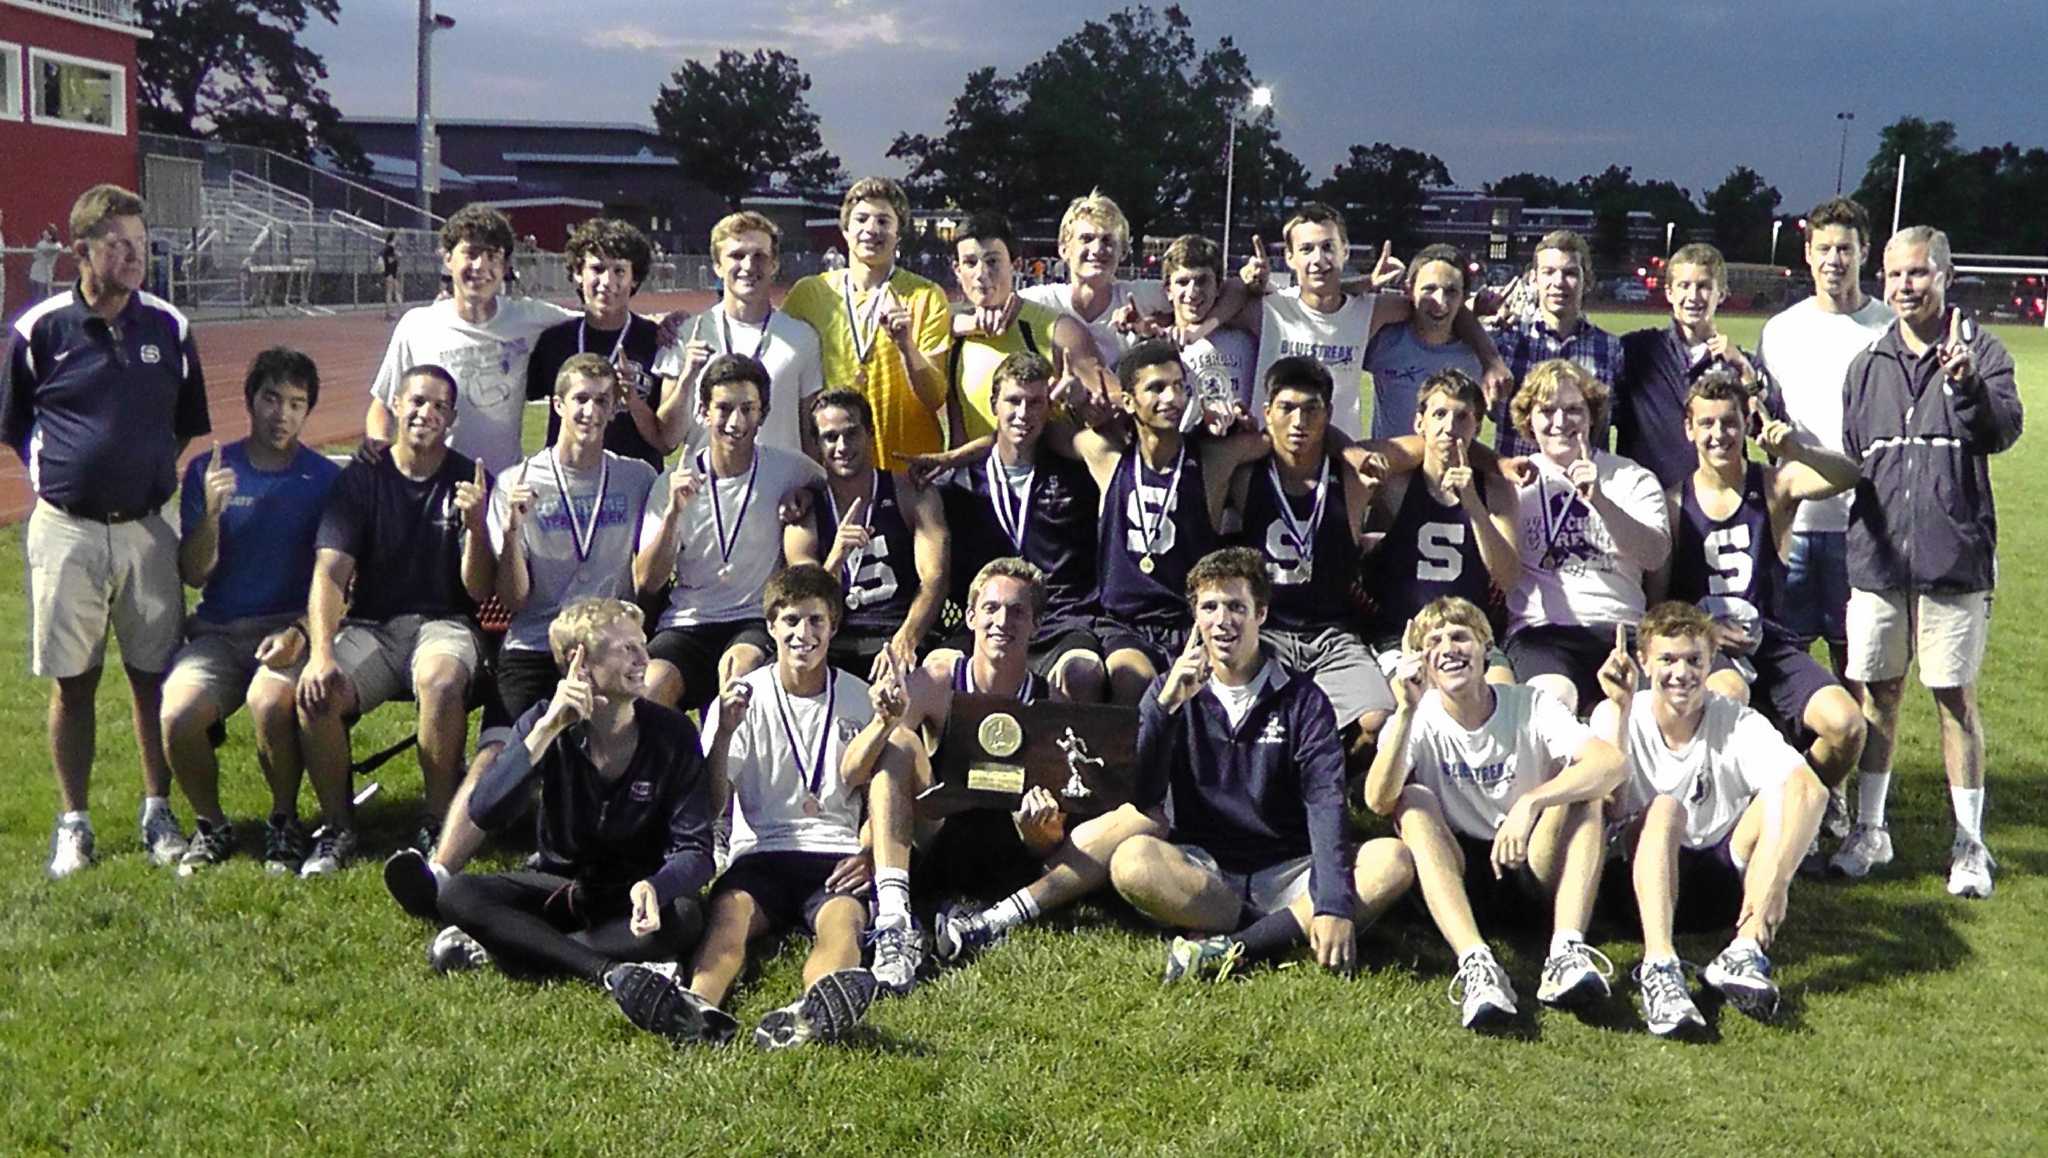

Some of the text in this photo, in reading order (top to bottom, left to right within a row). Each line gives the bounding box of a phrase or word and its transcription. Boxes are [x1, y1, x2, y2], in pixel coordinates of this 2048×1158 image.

[1127, 485, 1177, 555] S
[1265, 517, 1313, 584] S
[1416, 522, 1465, 582] S
[1704, 523, 1753, 595] S
